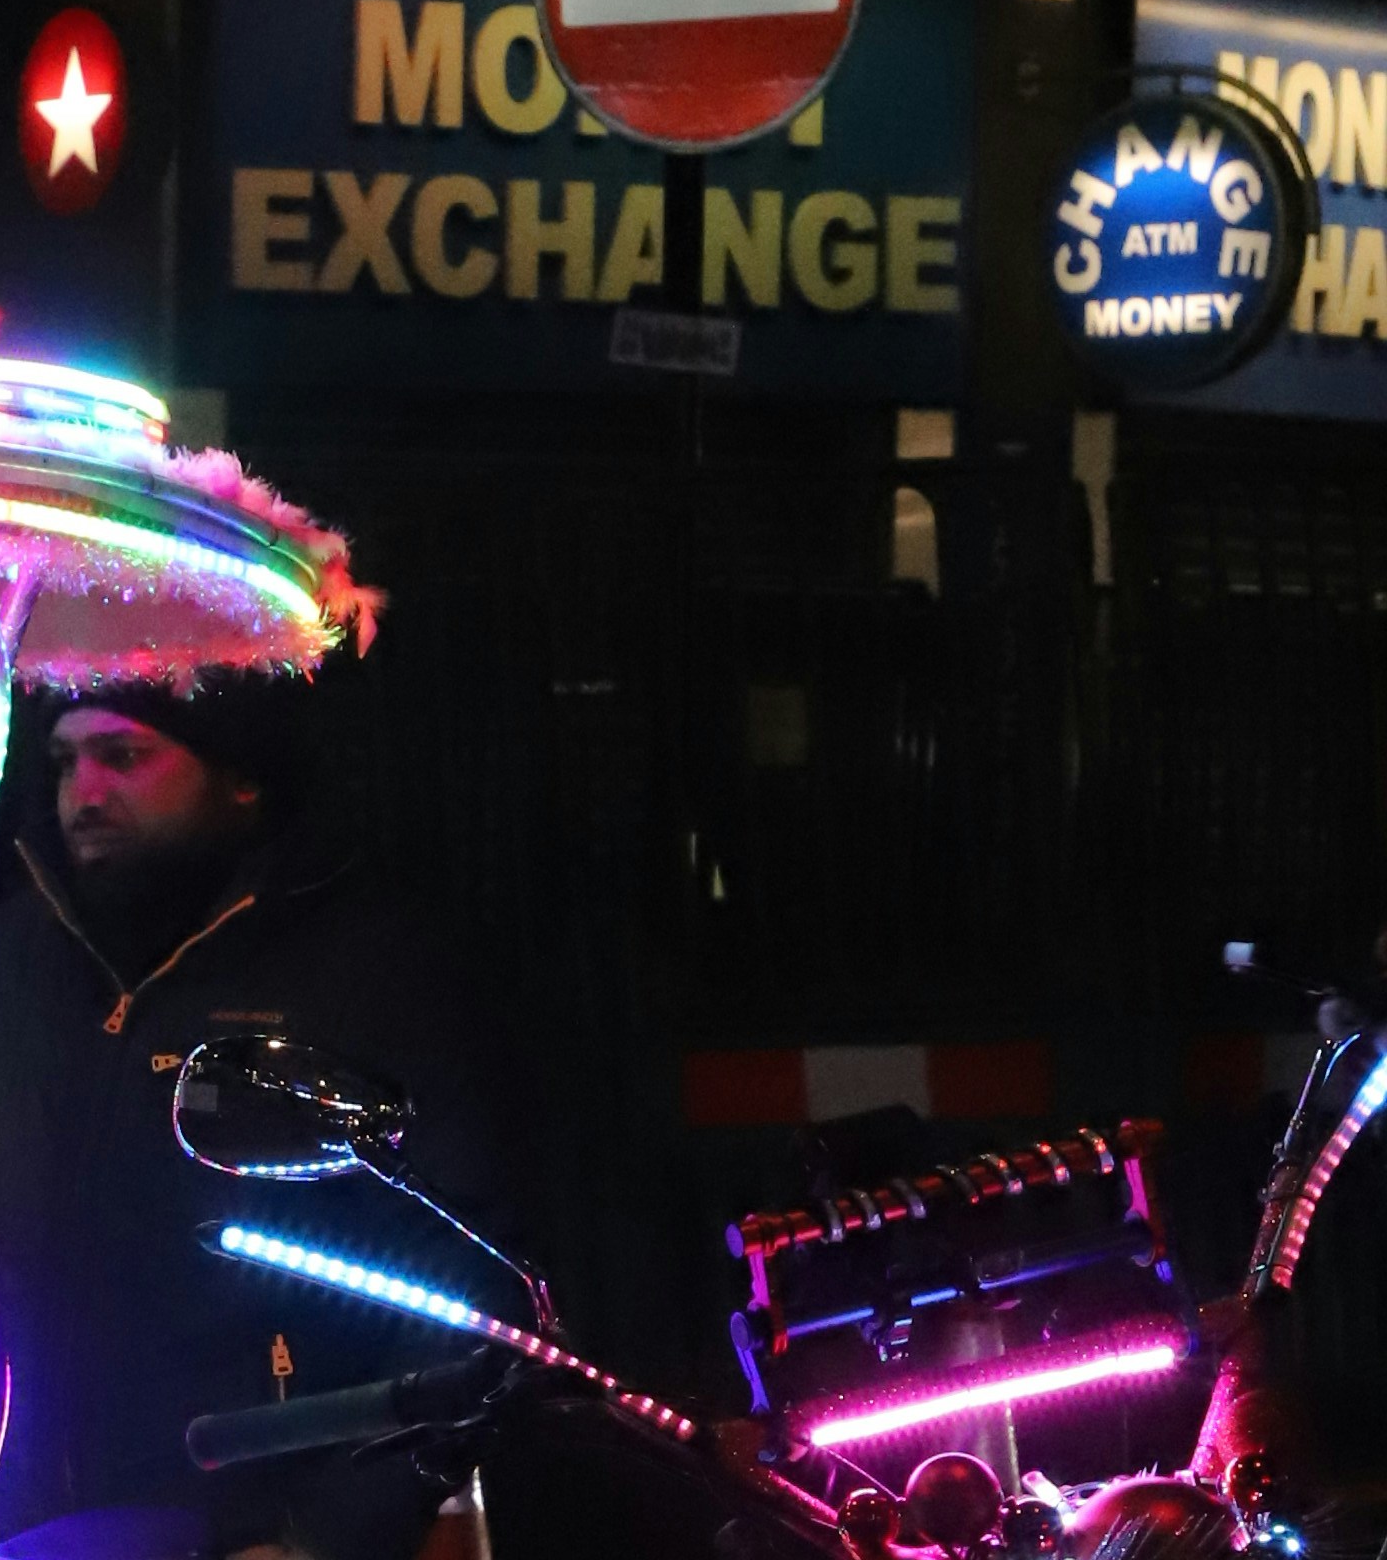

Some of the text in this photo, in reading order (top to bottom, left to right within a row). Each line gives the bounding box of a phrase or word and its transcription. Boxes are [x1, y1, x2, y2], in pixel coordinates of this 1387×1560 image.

[230, 167, 962, 314] EXCHANGE
[1053, 113, 1272, 295] CHANGE
[1121, 220, 1199, 258] ATM
[1083, 292, 1244, 338] MONEY
